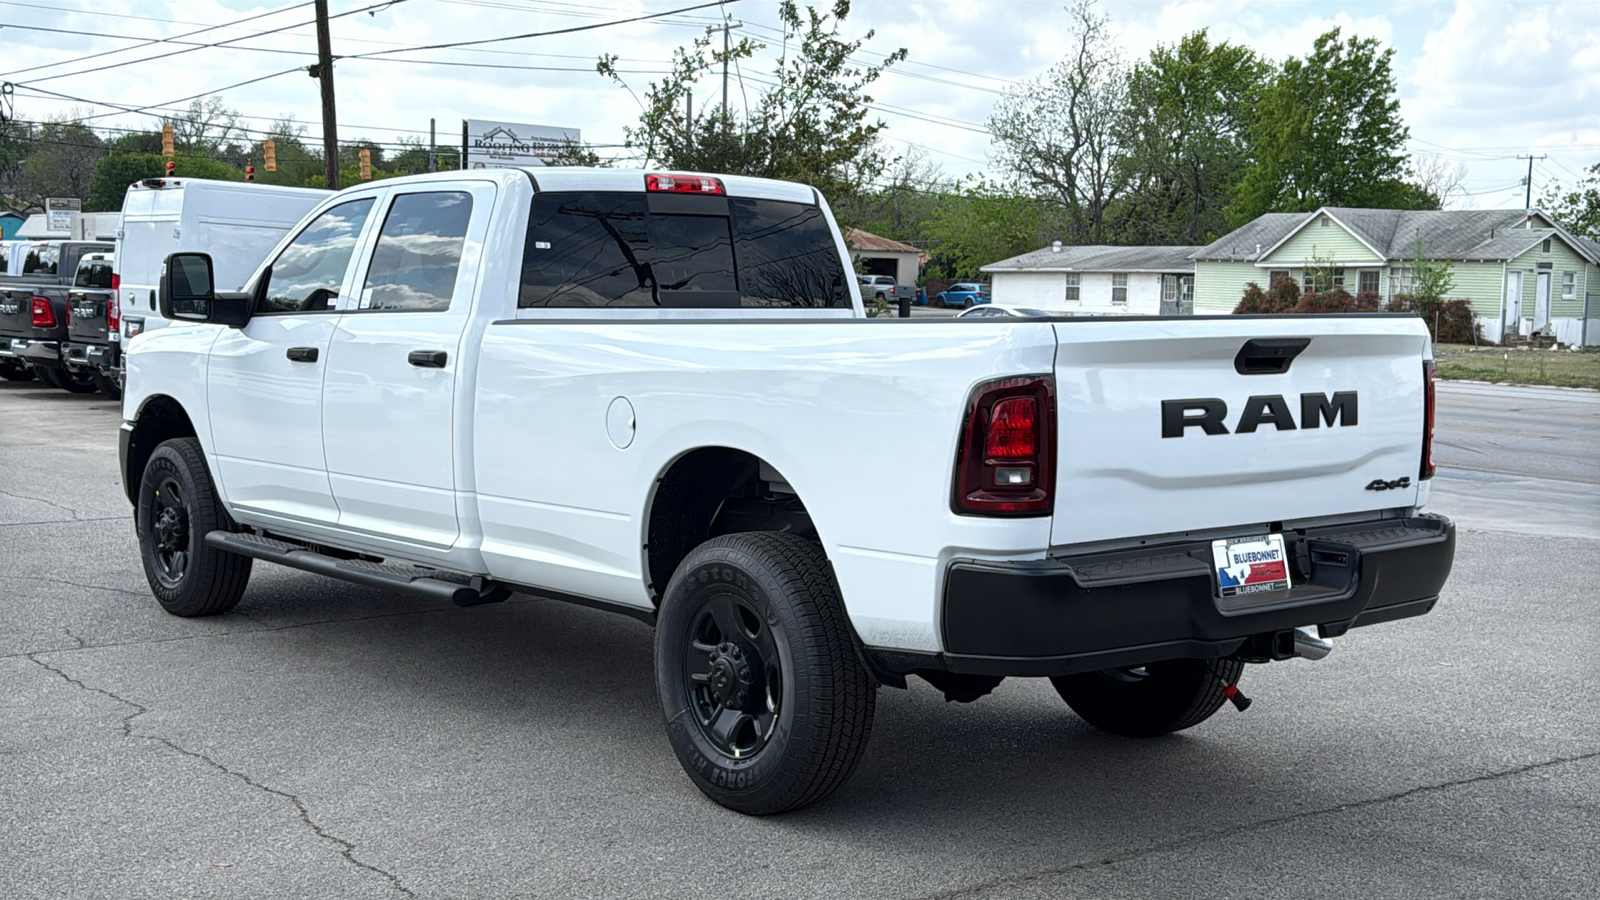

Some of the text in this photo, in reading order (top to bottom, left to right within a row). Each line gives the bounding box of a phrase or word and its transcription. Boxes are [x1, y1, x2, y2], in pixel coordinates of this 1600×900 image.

[474, 139, 530, 153] ROOFING
[1161, 390, 1358, 439] RAM
[1233, 549, 1279, 564] BLUEBONNET
[1235, 583, 1275, 595] BLUEBONNET
